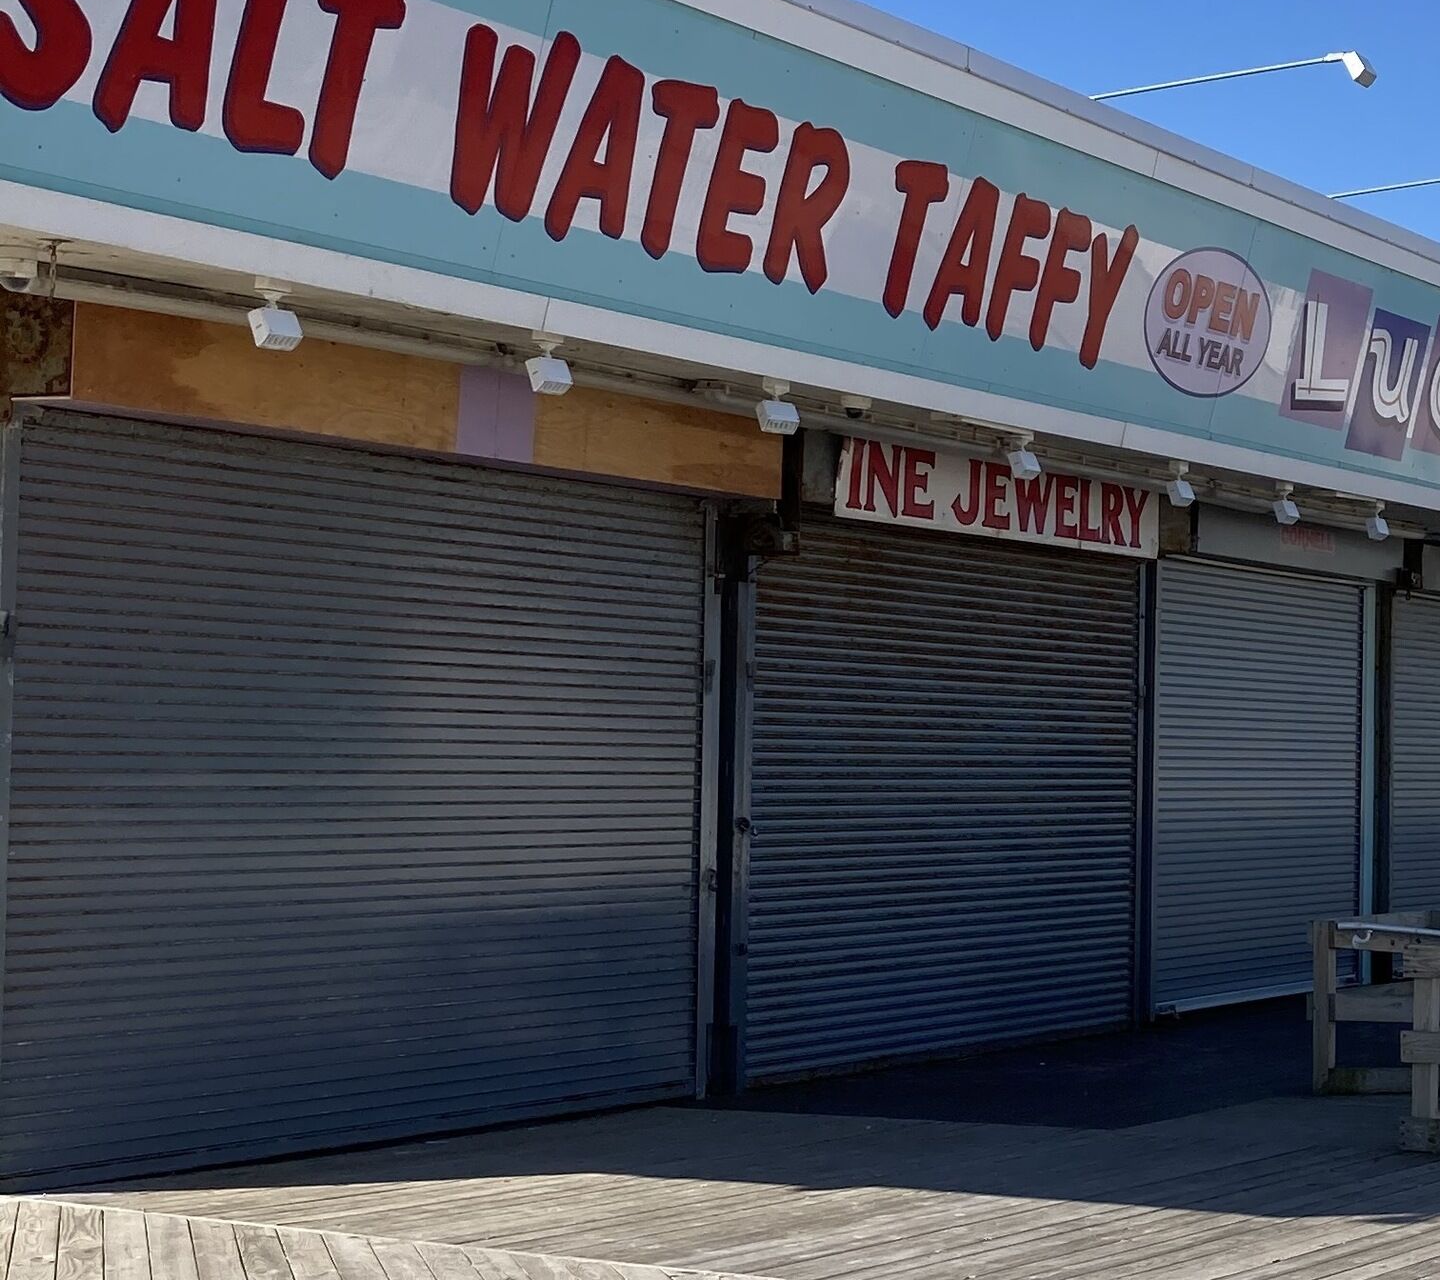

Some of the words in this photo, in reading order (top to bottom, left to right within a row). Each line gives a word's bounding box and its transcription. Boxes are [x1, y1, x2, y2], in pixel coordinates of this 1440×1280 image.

[450, 23, 850, 295] WATER
[882, 160, 1139, 370] TAFFY
[1162, 267, 1261, 344] OPEN
[1155, 327, 1193, 364] ALL
[1197, 336, 1245, 378] YEAR
[950, 458, 1151, 549] JEWELRY
